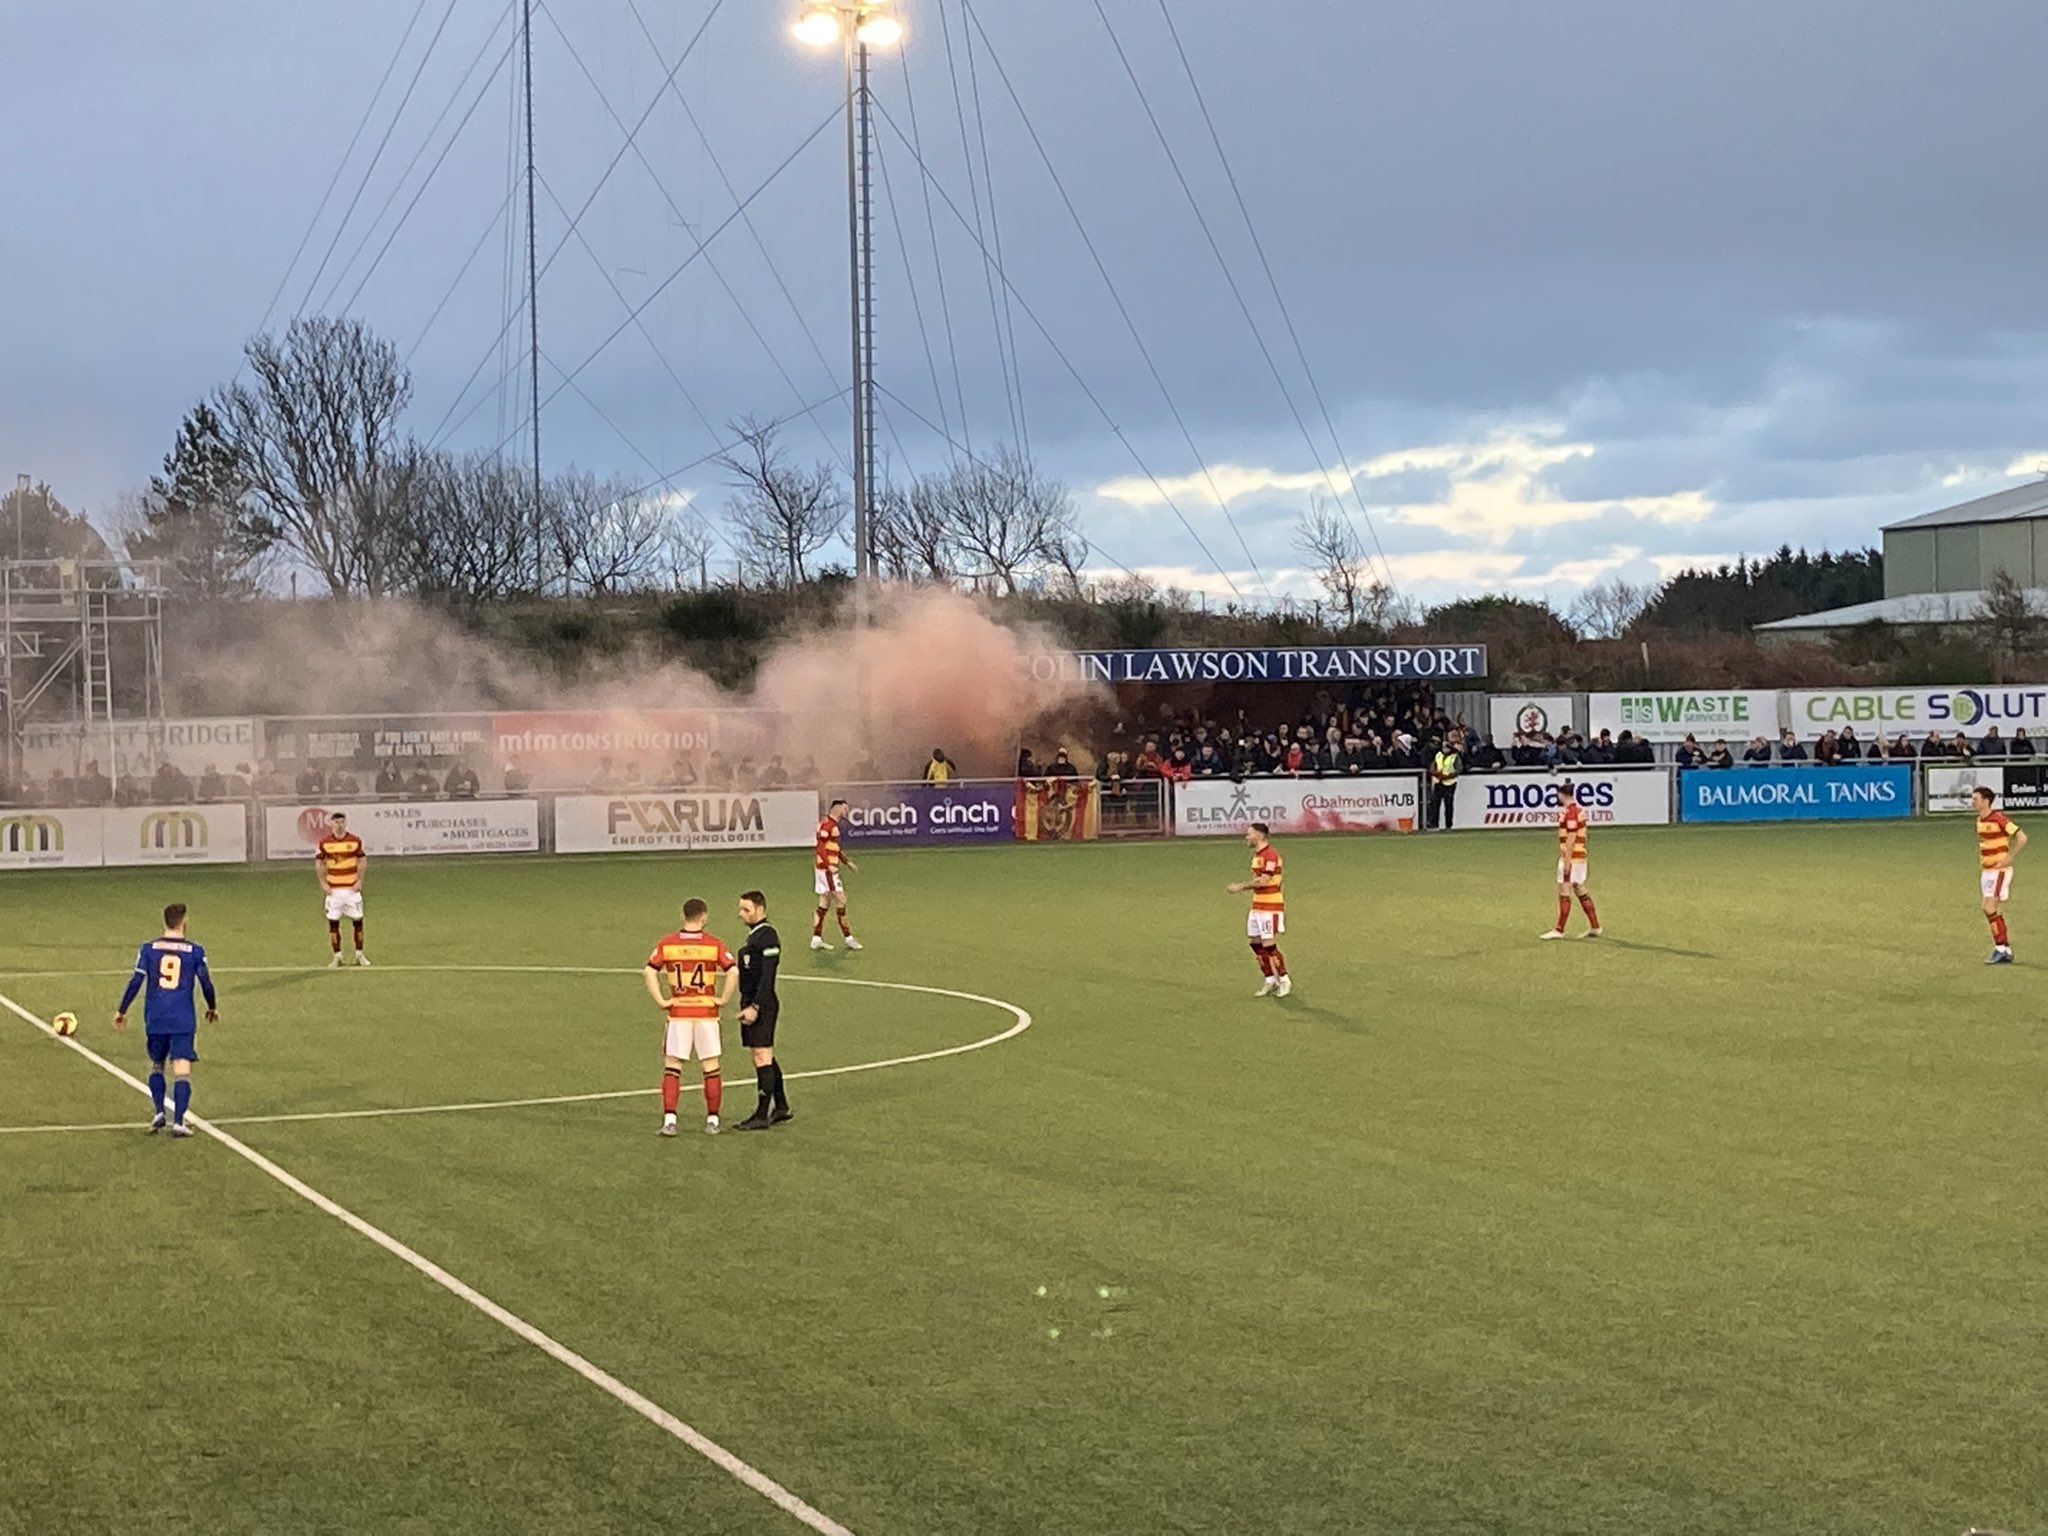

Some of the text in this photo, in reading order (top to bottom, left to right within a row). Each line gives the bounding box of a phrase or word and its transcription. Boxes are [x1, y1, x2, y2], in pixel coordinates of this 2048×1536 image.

[1124, 651, 1268, 680] LAWSON
[1277, 648, 1479, 678] TRANSPORT
[1656, 696, 1749, 723] WASTE
[1806, 694, 1915, 722] CABLE
[561, 730, 710, 750] CONSTRUCTION
[1484, 778, 1614, 808] moaes
[1699, 780, 1895, 806] BALMORAL TANKS
[383, 808, 422, 819] SALES
[415, 817, 487, 828] PURCHASES
[849, 801, 918, 827] cinch
[930, 797, 1000, 824] cinch
[1186, 805, 1287, 823] ELEVATOR
[450, 828, 529, 839] MORTGAGES
[612, 833, 765, 845] ENERGY TECHNOLOGIES
[159, 953, 182, 989] 9
[673, 962, 707, 993] 14
